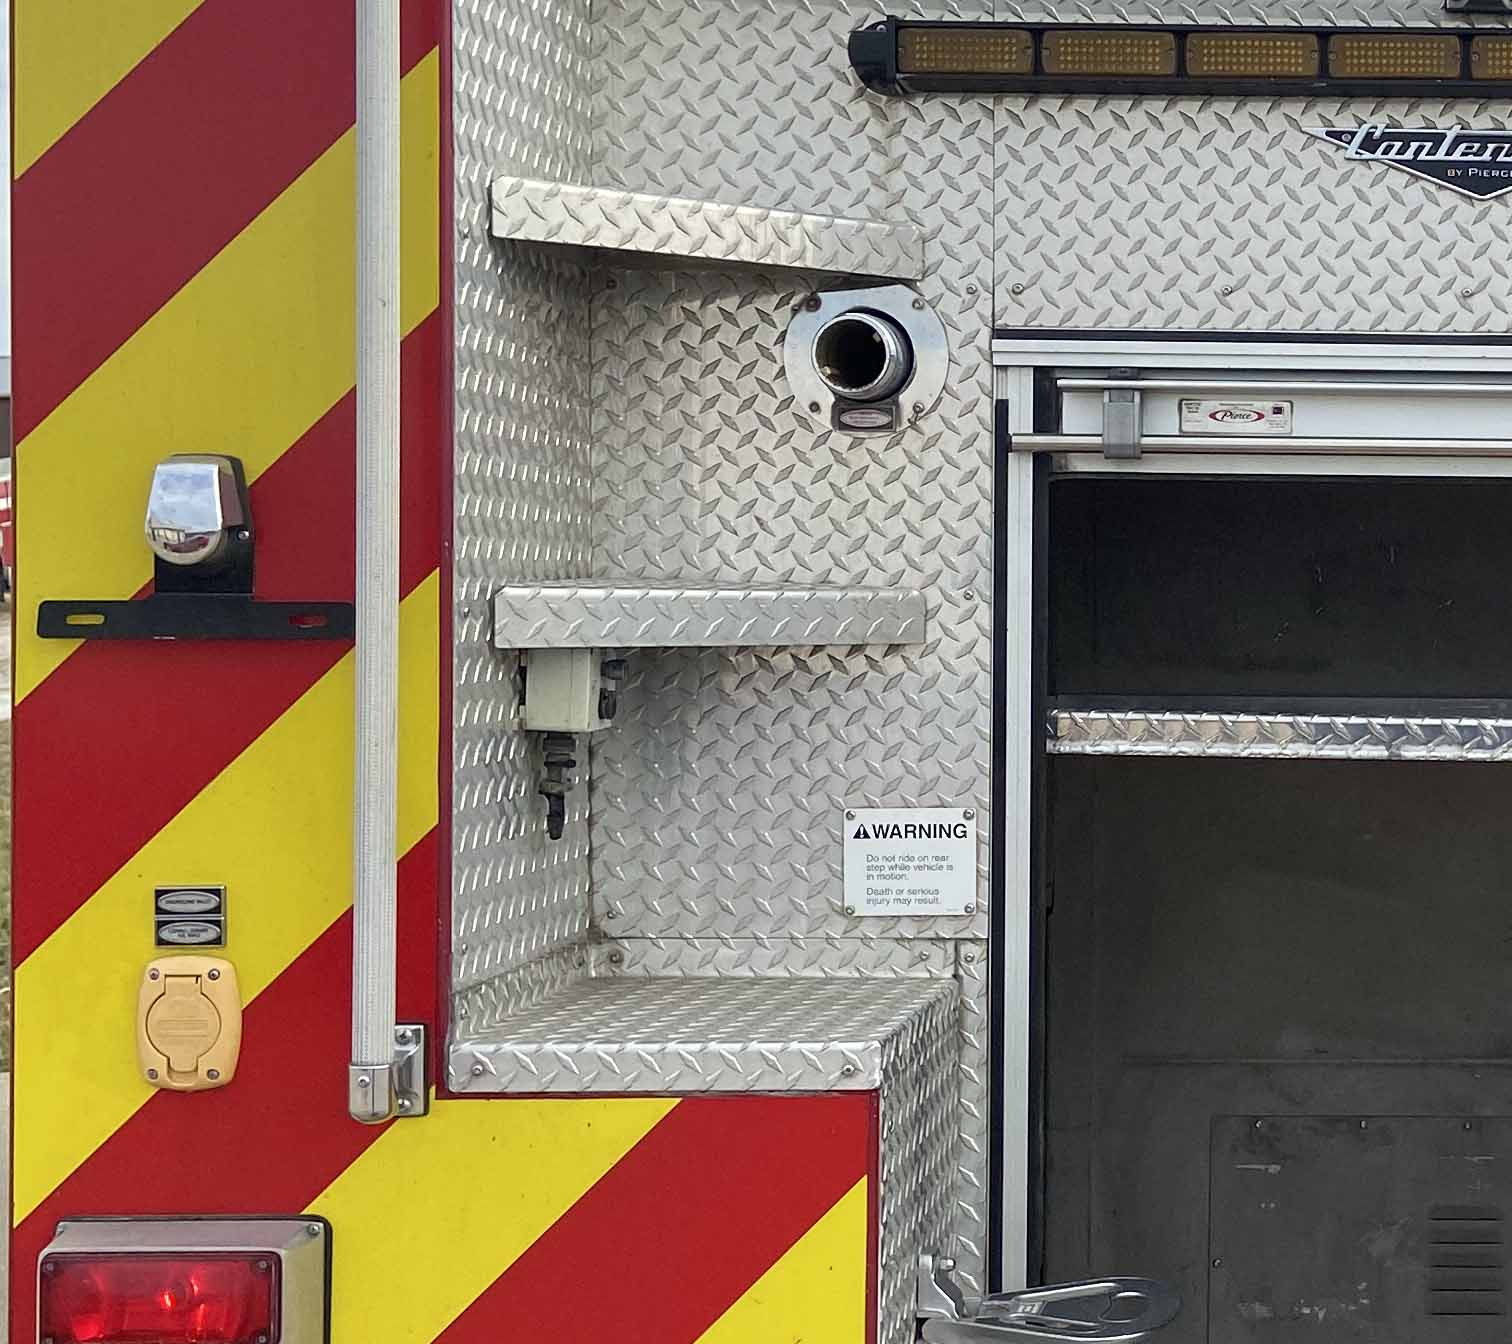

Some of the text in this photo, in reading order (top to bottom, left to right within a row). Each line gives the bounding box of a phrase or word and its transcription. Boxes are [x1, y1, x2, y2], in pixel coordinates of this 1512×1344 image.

[1447, 168, 1463, 177] BY
[1220, 408, 1253, 422] Pierce
[871, 823, 968, 839] WARNING
[866, 853, 950, 863] Do not ride on rear
[866, 863, 954, 873] step while vehicle is
[866, 872, 910, 881] in motion.
[866, 887, 940, 896] Death or serious
[866, 896, 942, 907] injury may result.
